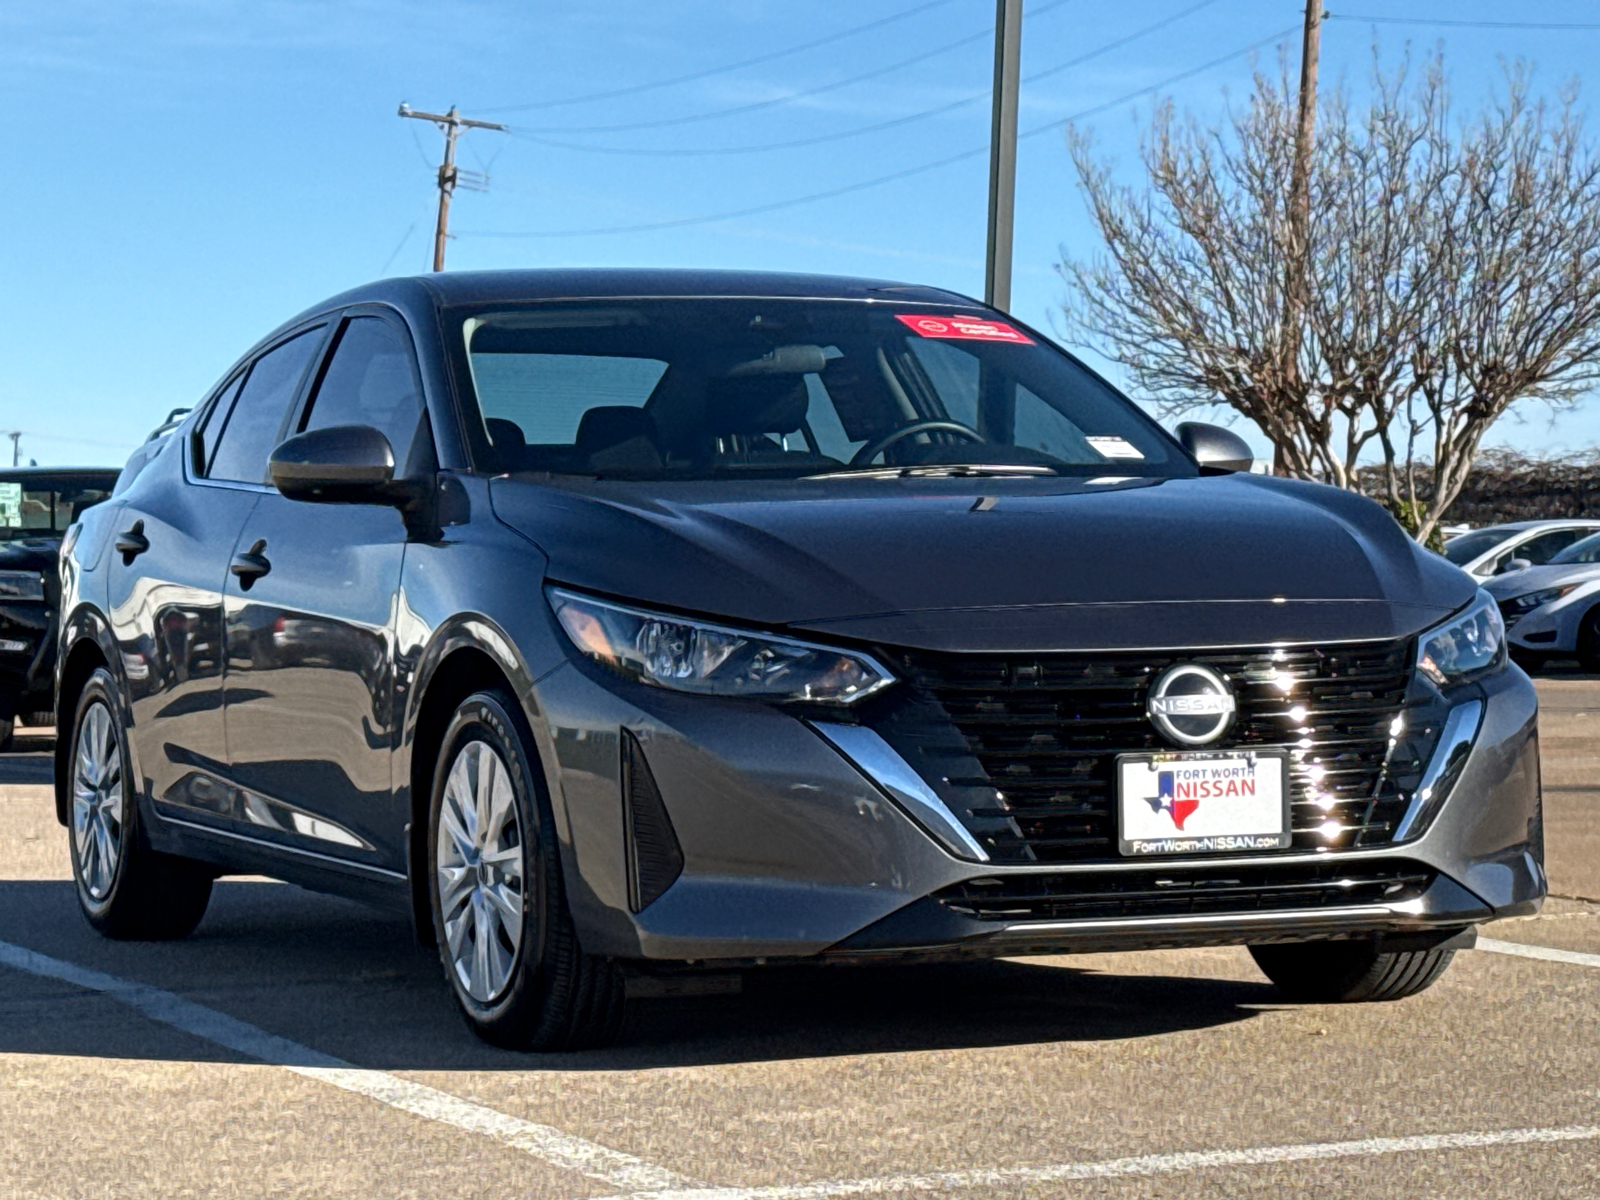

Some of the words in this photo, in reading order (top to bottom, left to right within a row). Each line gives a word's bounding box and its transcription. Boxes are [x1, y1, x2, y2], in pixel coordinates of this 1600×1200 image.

[1151, 697, 1234, 713] NISSAN
[1176, 769, 1208, 780] FORT
[1211, 767, 1256, 779] WORTH
[1176, 779, 1256, 798] NISSAN
